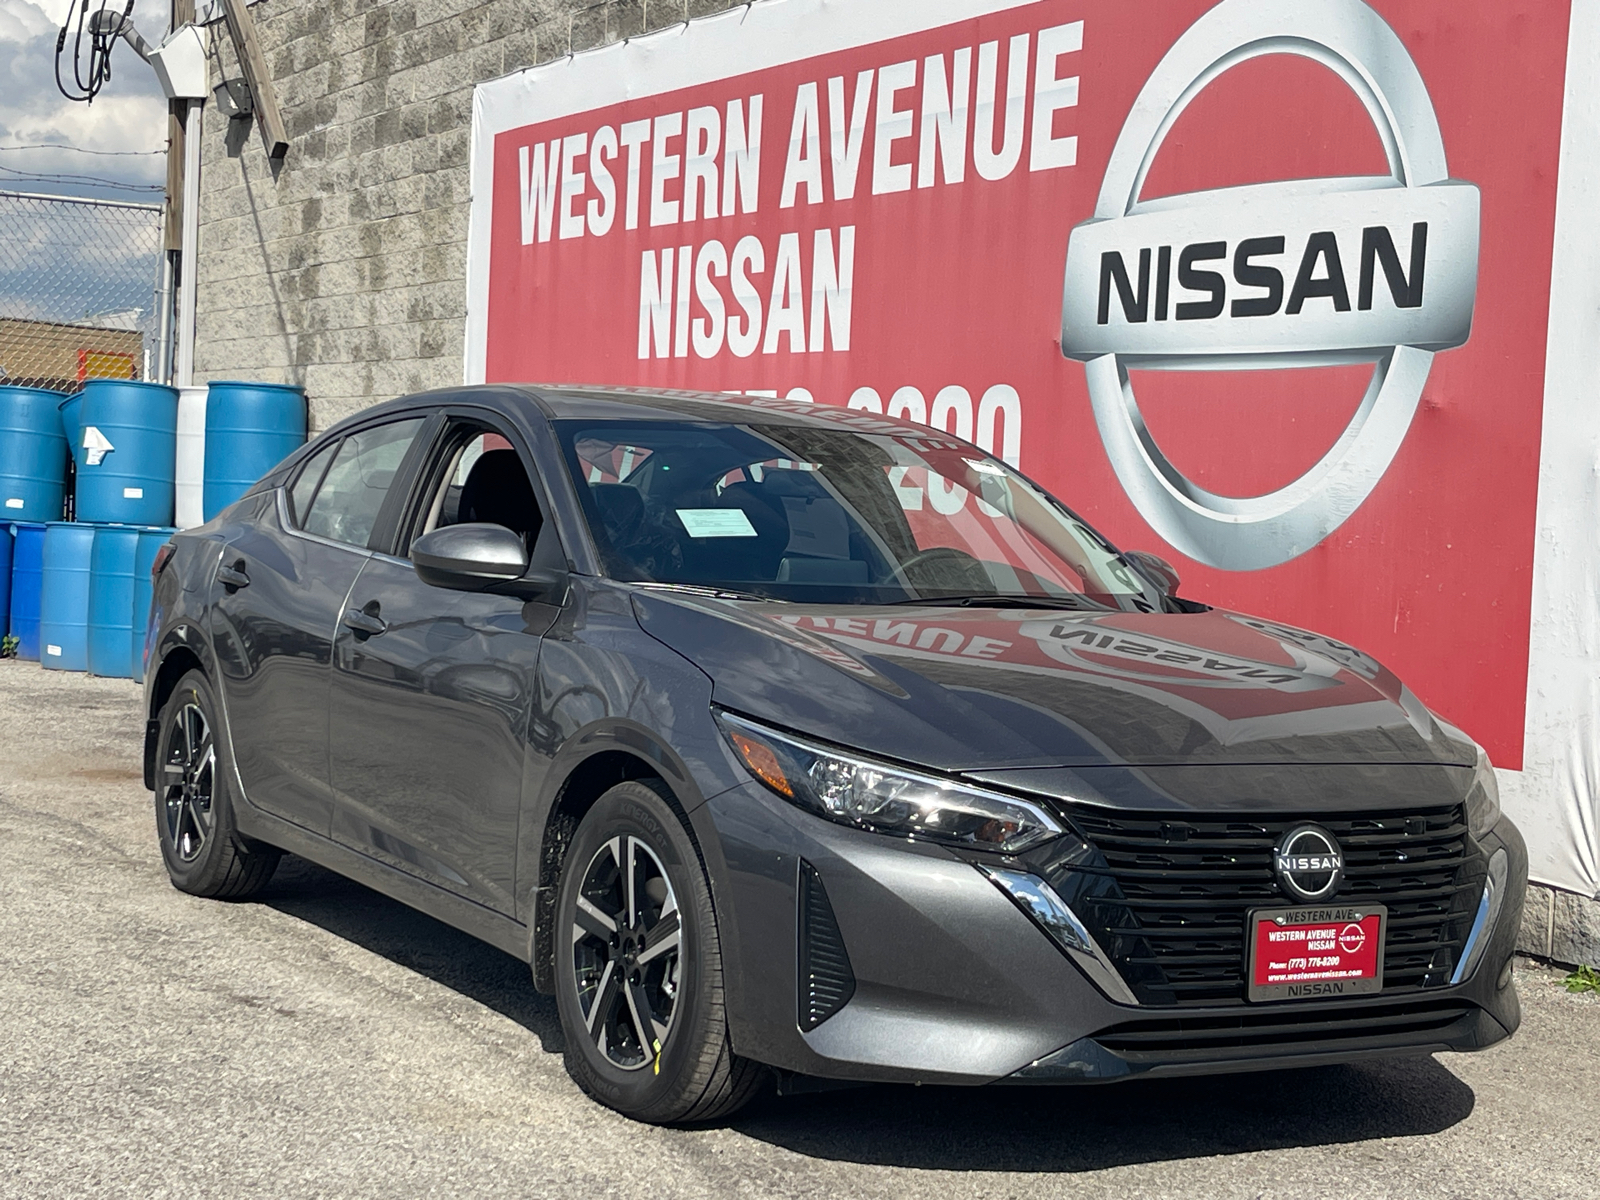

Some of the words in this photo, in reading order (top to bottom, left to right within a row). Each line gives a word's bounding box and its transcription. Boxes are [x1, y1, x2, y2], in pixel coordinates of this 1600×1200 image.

[519, 94, 763, 245] WESTERN
[780, 20, 1084, 209] AVENUE
[1097, 222, 1428, 325] NISSAN
[638, 225, 855, 359] NISSAN
[1278, 857, 1341, 869] NISSAN
[1285, 910, 1332, 923] WESTERN
[1268, 930, 1306, 942] WESTERN
[1306, 929, 1336, 940] AVENUE
[1308, 940, 1336, 950] NISSAN
[1288, 958, 1307, 970] (773)
[1308, 956, 1340, 967] 776-8200
[1288, 982, 1344, 996] NISSAN
